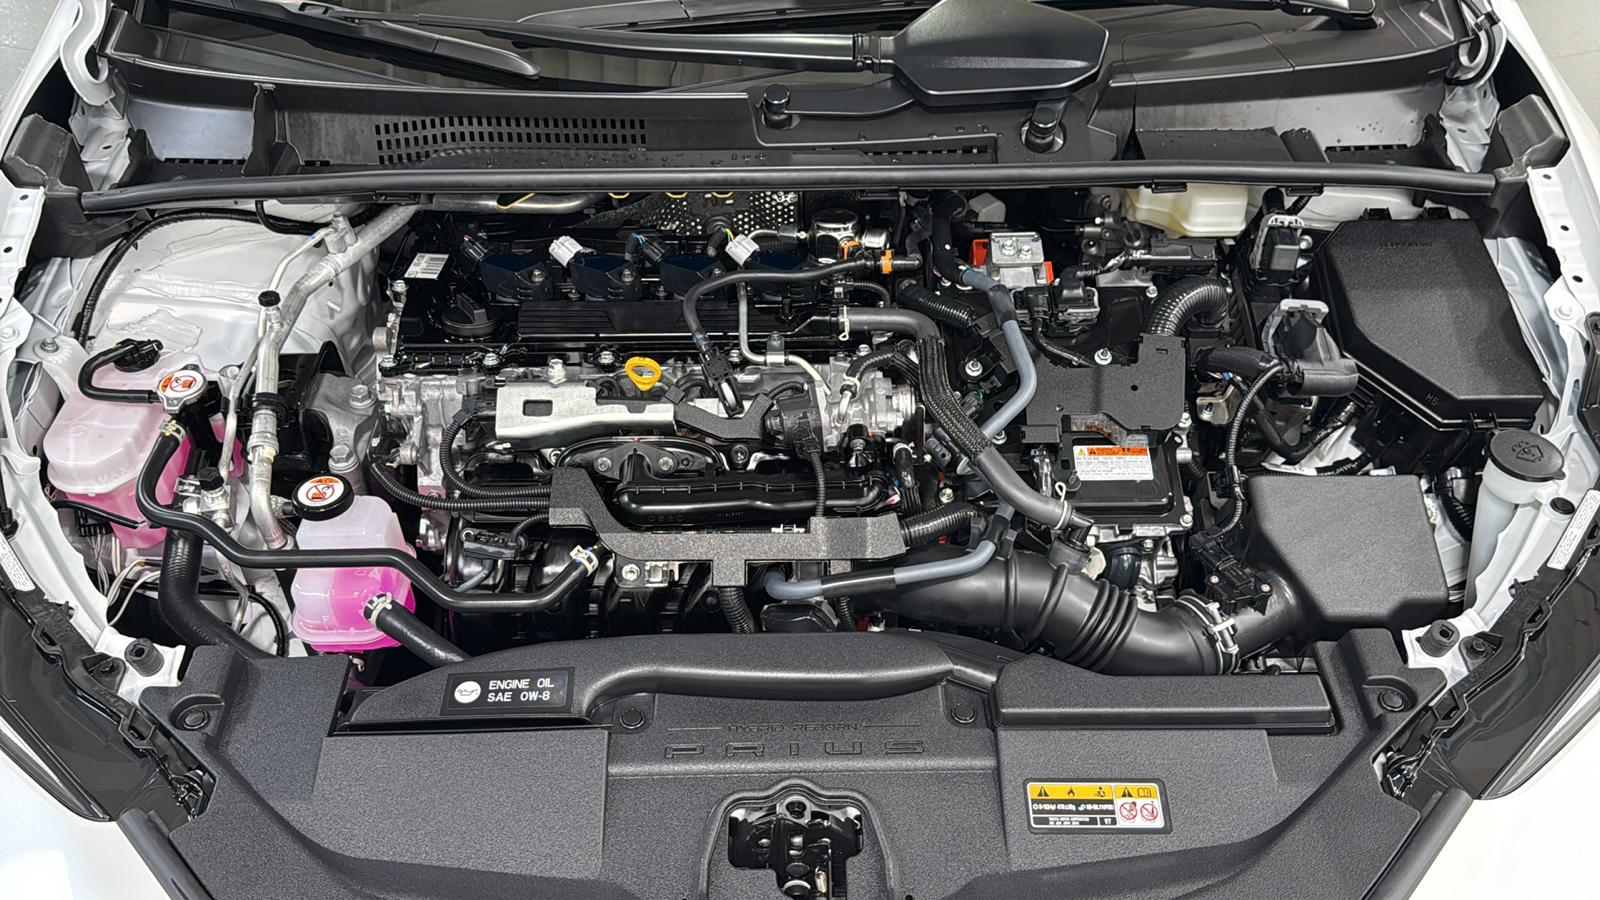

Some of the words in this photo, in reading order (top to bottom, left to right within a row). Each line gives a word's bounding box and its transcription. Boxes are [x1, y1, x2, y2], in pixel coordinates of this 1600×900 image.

[488, 678, 531, 690] ENGINE
[536, 677, 555, 689] OIL
[487, 691, 513, 703] SAE
[727, 724, 784, 733] HYBRID
[792, 723, 859, 732] REBORN
[664, 740, 925, 759] PRIUS
